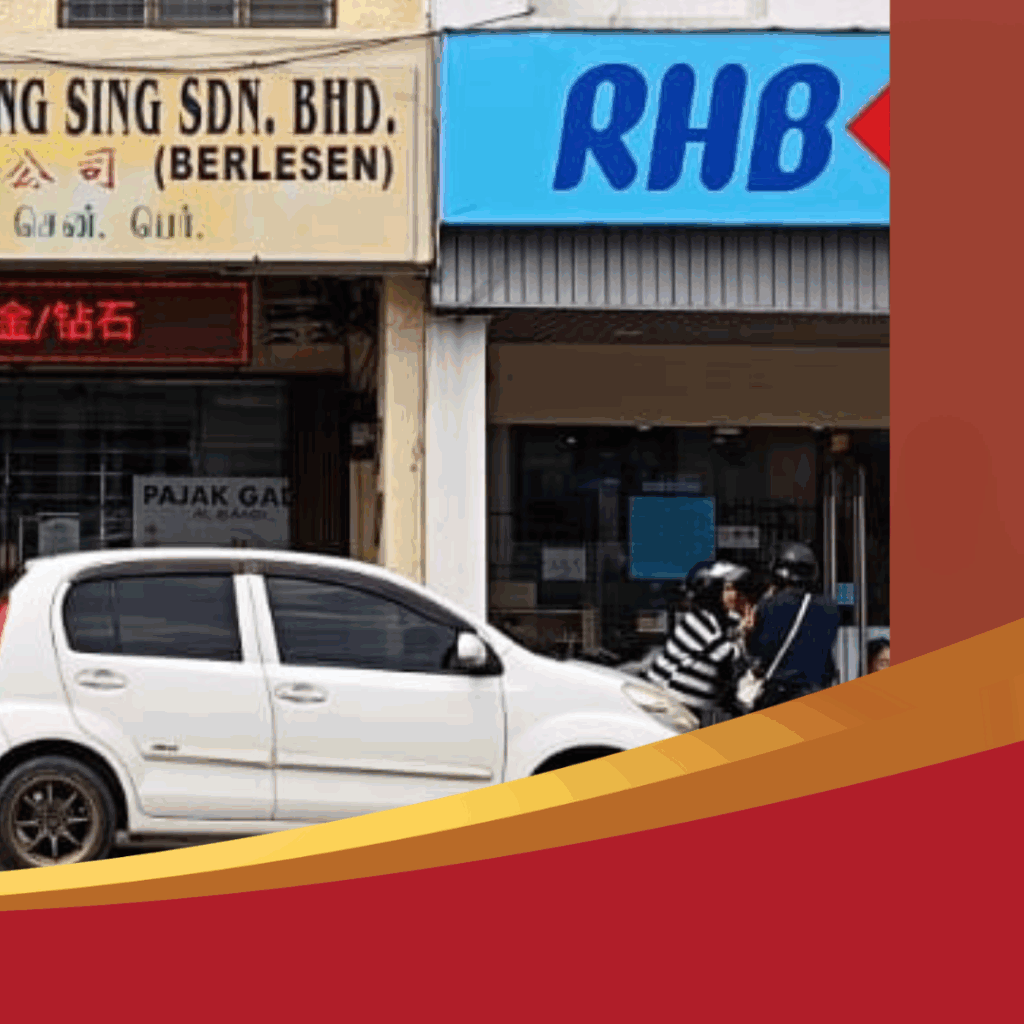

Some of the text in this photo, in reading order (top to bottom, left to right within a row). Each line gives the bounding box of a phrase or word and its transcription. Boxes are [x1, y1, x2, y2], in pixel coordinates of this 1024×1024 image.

[65, 77, 162, 135] SING
[179, 77, 276, 135] SDN.
[293, 78, 397, 135] BHD.
[552, 62, 842, 192] RHB
[154, 144, 394, 191] (BERLESEN)
[144, 485, 229, 506] PAJAK
